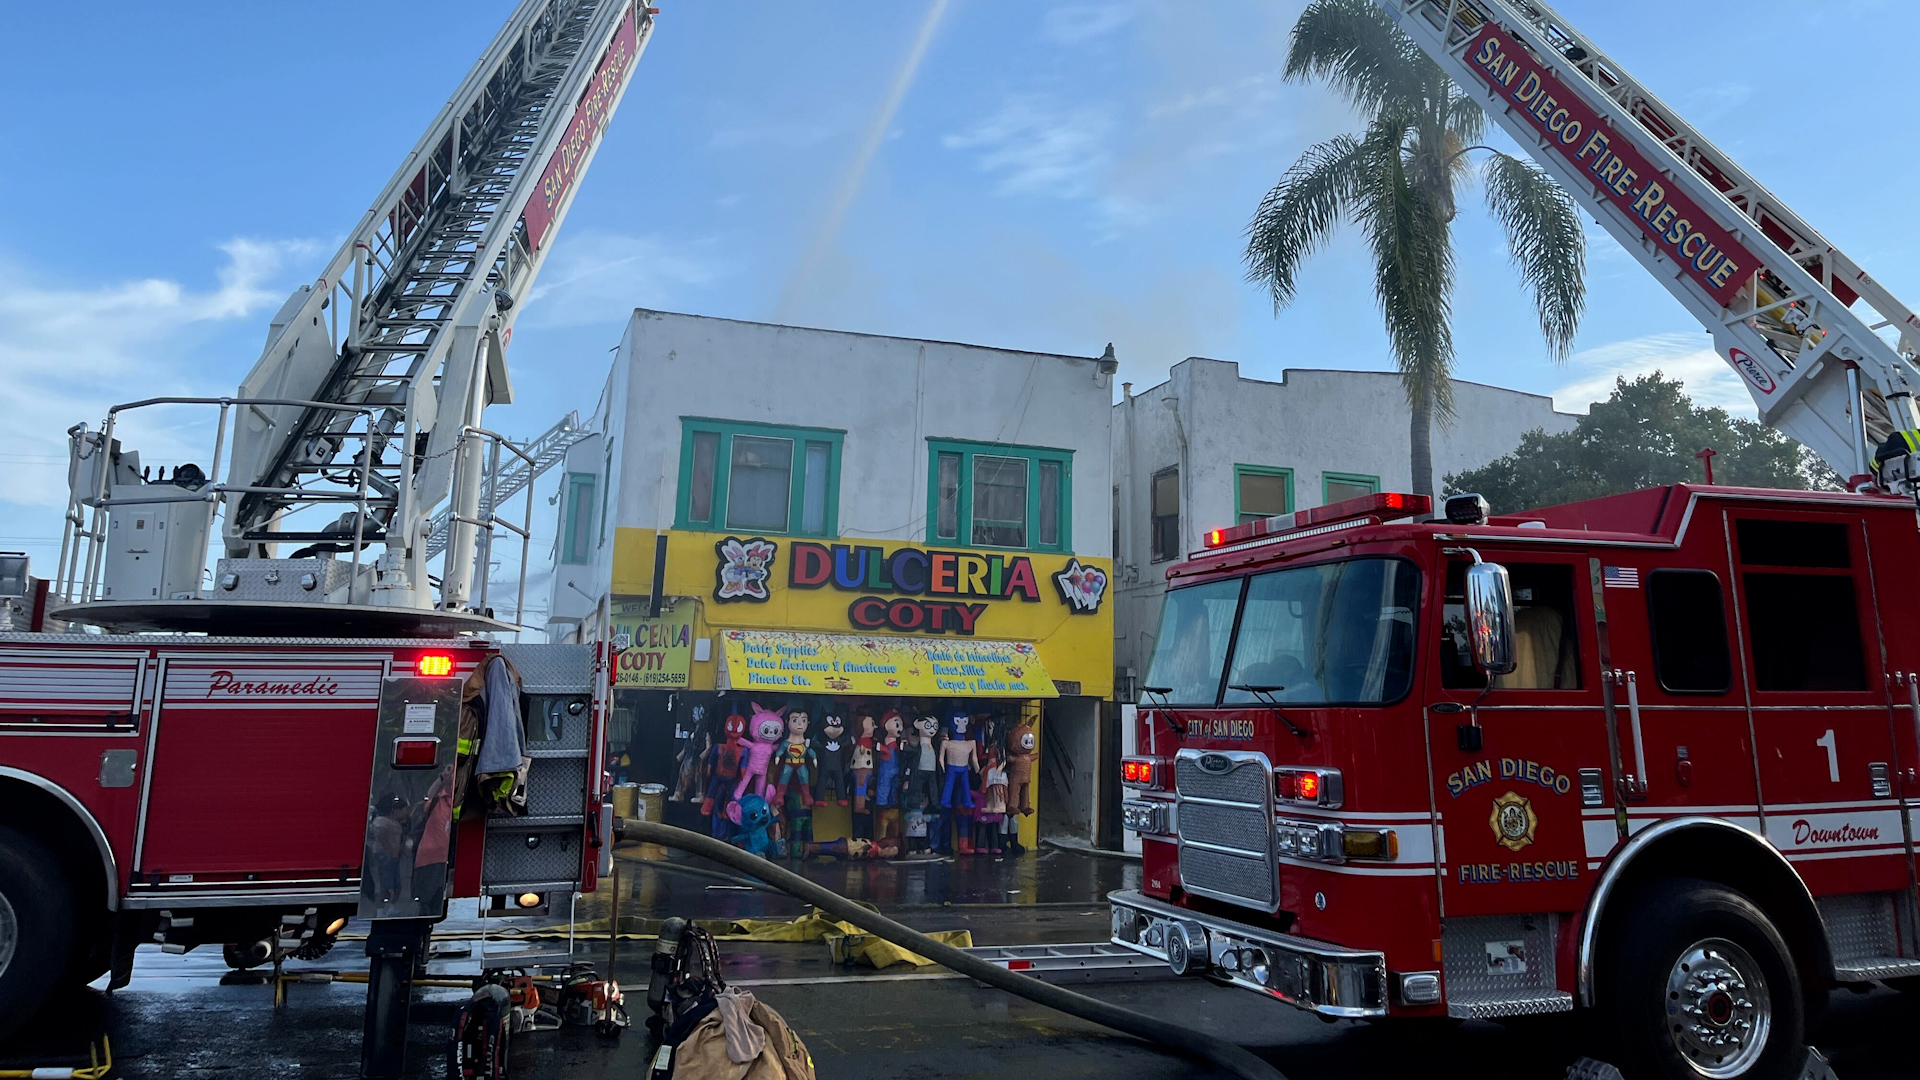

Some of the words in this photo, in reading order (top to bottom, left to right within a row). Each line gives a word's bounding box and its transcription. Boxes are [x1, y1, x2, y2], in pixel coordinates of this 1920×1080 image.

[544, 163, 563, 211] SAN
[561, 120, 586, 177] DIEGO
[585, 40, 626, 131] FIRE-RESCUE
[1474, 36, 1521, 88] SAN
[1512, 69, 1583, 146] DIEGO
[1576, 128, 1740, 289] FIRE-RESCUE
[1737, 355, 1769, 388] Pierce
[793, 544, 1039, 600] DULCERIA
[853, 601, 982, 632] COTY
[620, 651, 667, 671] COTY
[747, 656, 777, 669] Dulce
[779, 658, 830, 671] Mexicano
[833, 660, 840, 671] Y
[844, 660, 897, 674] Americano
[776, 642, 819, 660] Supplies
[954, 650, 966, 662] de
[206, 670, 339, 699] Paramedic
[616, 672, 639, 683] 26-0146
[977, 679, 1007, 691] Mucho
[1145, 710, 1156, 755] 1
[1187, 720, 1203, 738] CITY
[1213, 720, 1229, 739] SAN
[1230, 720, 1255, 740] DIEGO
[1816, 728, 1840, 783] 1
[1447, 759, 1493, 799] SAN
[1499, 758, 1571, 796] DIEGO
[1792, 819, 1880, 846] Downtown
[1458, 861, 1579, 884] FIRE-RESCUE
